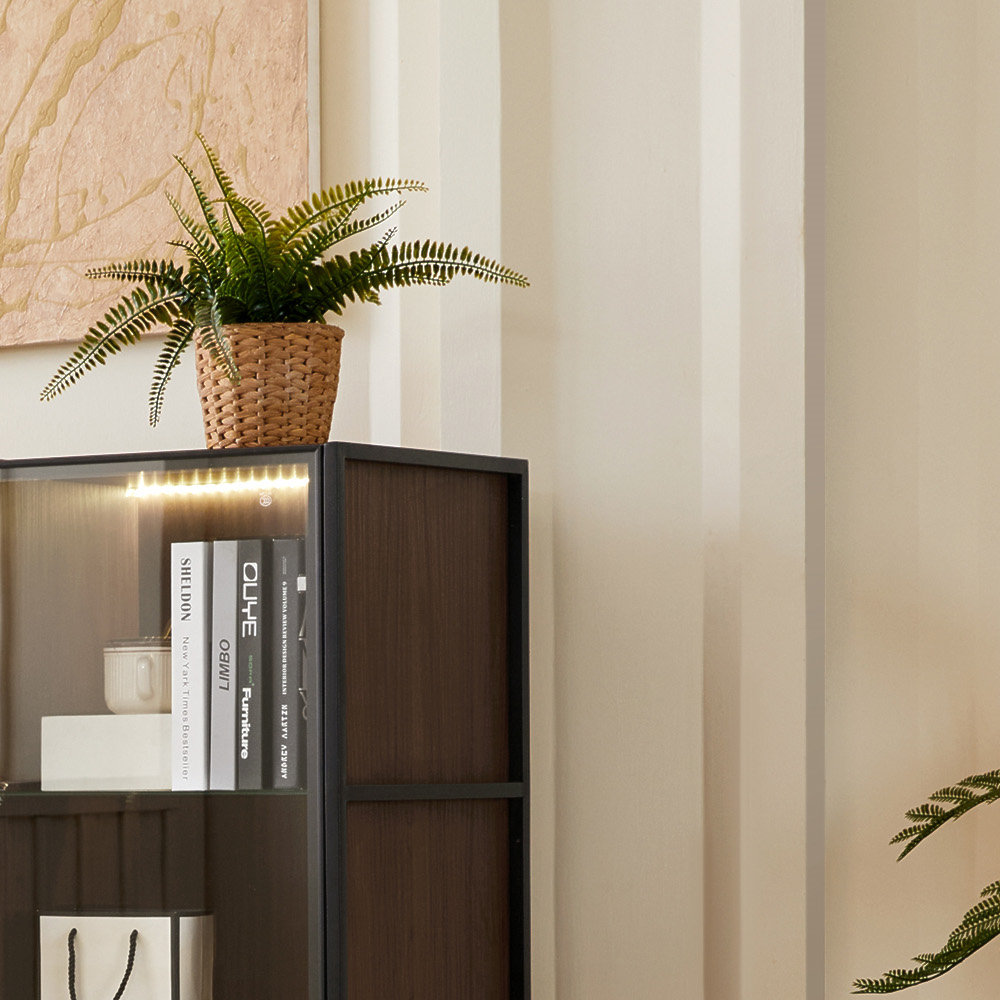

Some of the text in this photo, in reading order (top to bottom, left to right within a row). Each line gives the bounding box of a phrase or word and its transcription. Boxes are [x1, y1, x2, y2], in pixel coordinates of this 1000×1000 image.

[180, 558, 192, 621] SHELDON
[182, 636, 190, 660] New
[218, 639, 231, 691] LIMBO
[241, 687, 251, 760] Furniture
